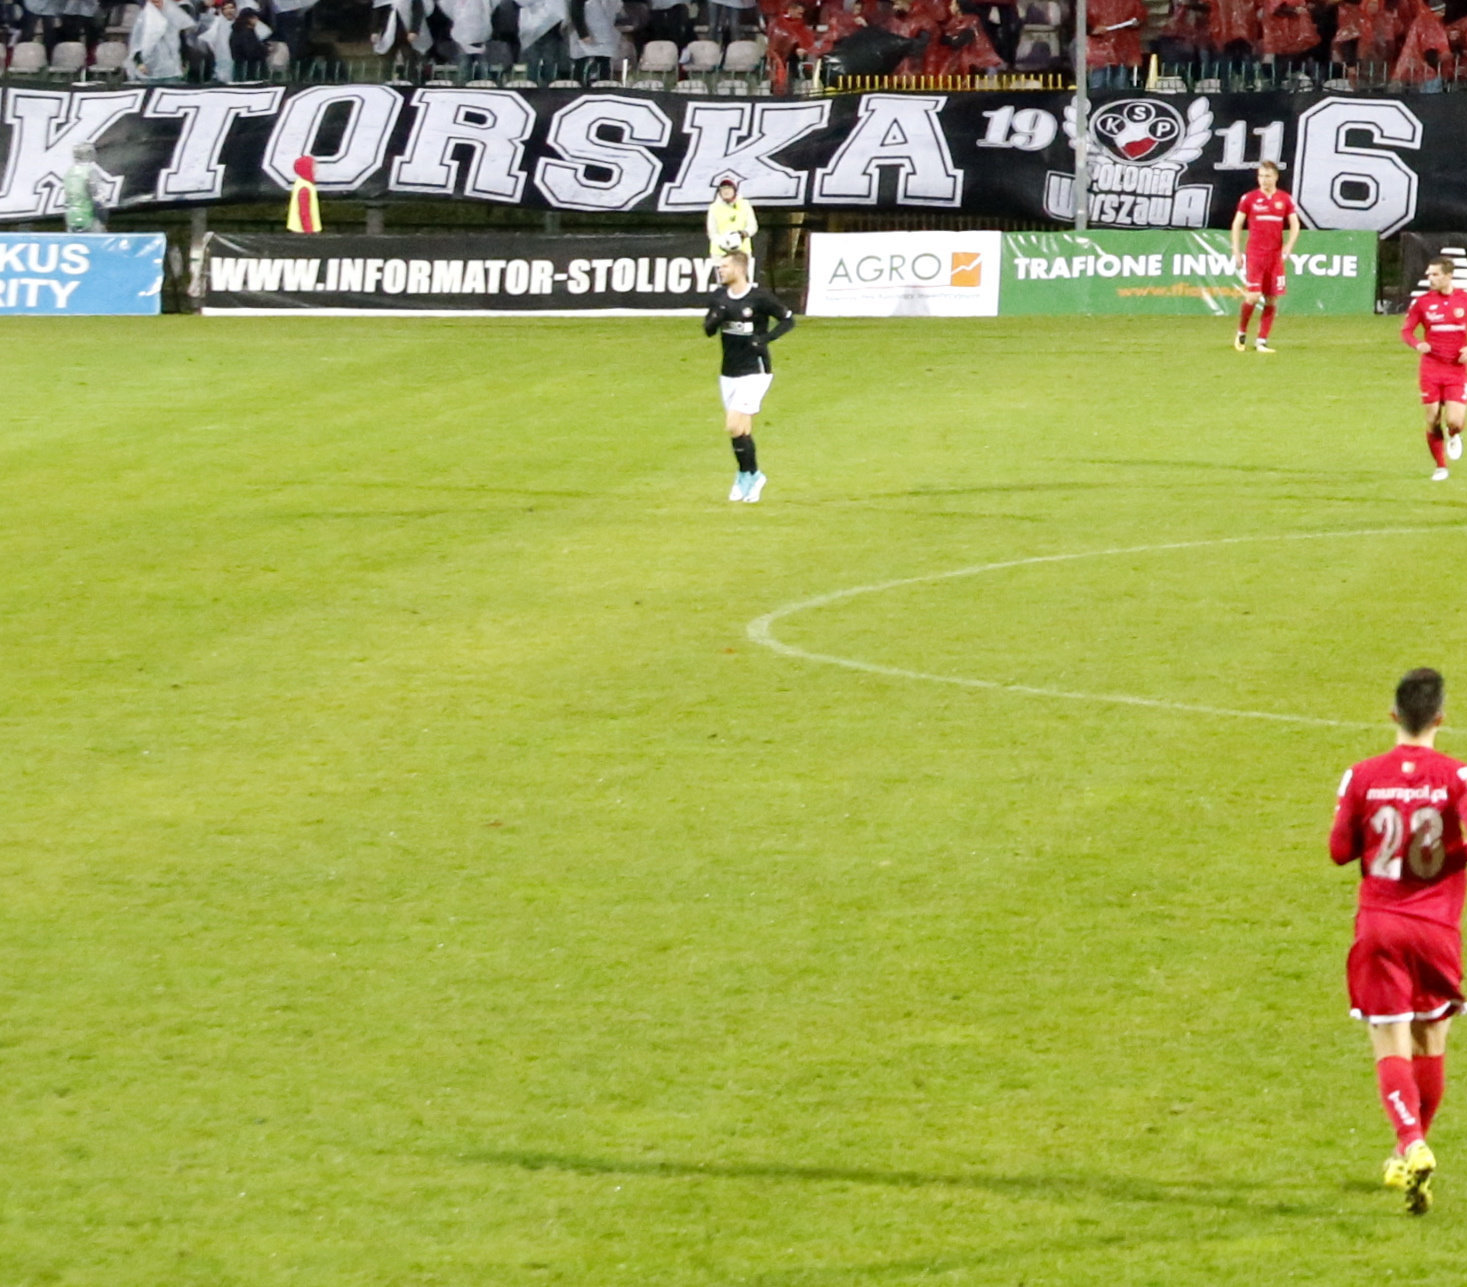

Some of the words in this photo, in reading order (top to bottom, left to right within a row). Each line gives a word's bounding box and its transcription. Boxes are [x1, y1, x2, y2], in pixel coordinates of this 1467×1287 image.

[0, 84, 964, 218] KTORSKA
[1297, 96, 1423, 240] 6
[977, 105, 1058, 151] 19
[1213, 120, 1287, 170] 11
[210, 256, 758, 294] WWW.INFORMATOR-STOLICY.L
[828, 253, 942, 284] AGRO
[1014, 254, 1162, 279] TRAFIONE
[1173, 253, 1357, 277] INWYCJE
[1369, 805, 1446, 880] 28
